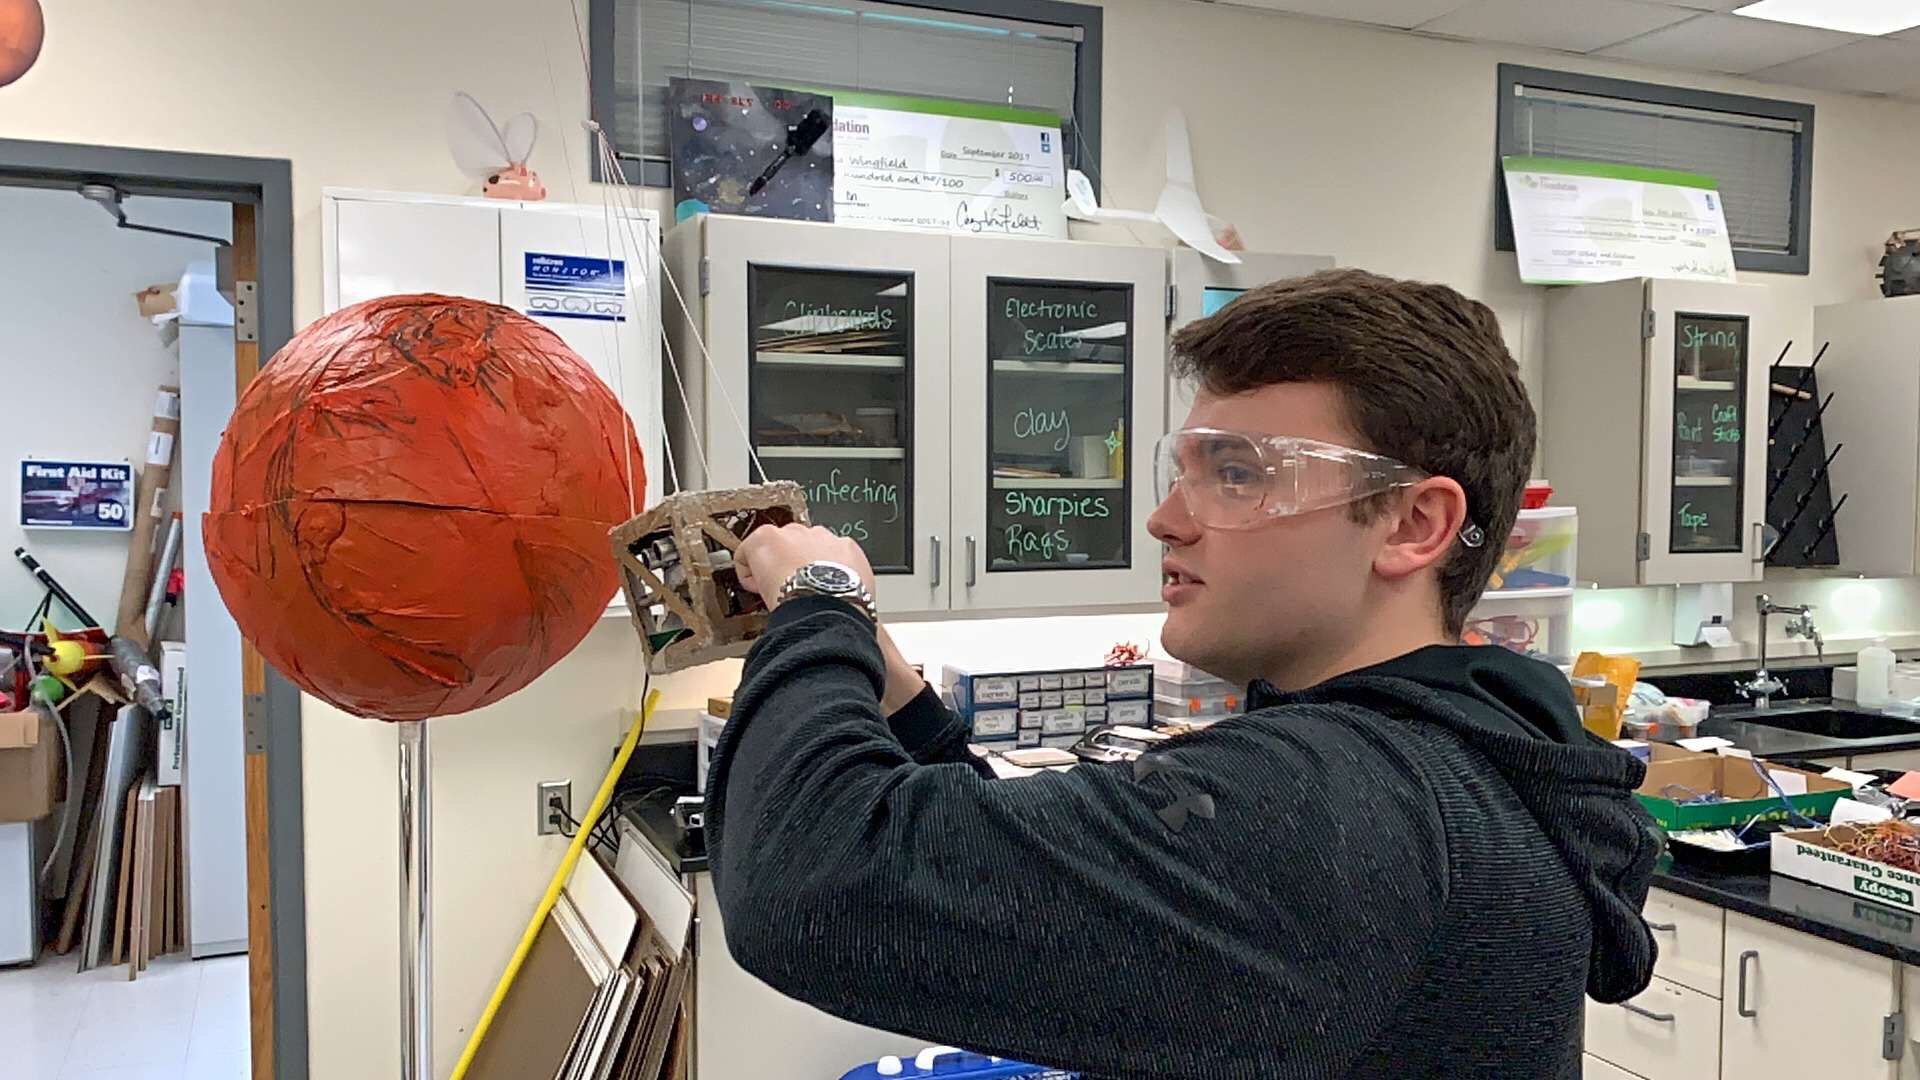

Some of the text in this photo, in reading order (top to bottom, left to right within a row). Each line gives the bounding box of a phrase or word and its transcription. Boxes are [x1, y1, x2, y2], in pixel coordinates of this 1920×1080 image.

[962, 146, 1004, 159] September
[849, 156, 909, 170] Wingfield
[532, 265, 600, 276] MONITOR
[1005, 298, 1098, 318] Electronic
[26, 465, 126, 480] First Aid Kit
[99, 503, 122, 520] 50
[1005, 492, 1110, 524] Sharpies
[1678, 503, 1709, 532] Tape
[1006, 525, 1070, 560] Rags
[1796, 844, 1883, 878] Guaranteed
[1858, 879, 1910, 903] e-copy
